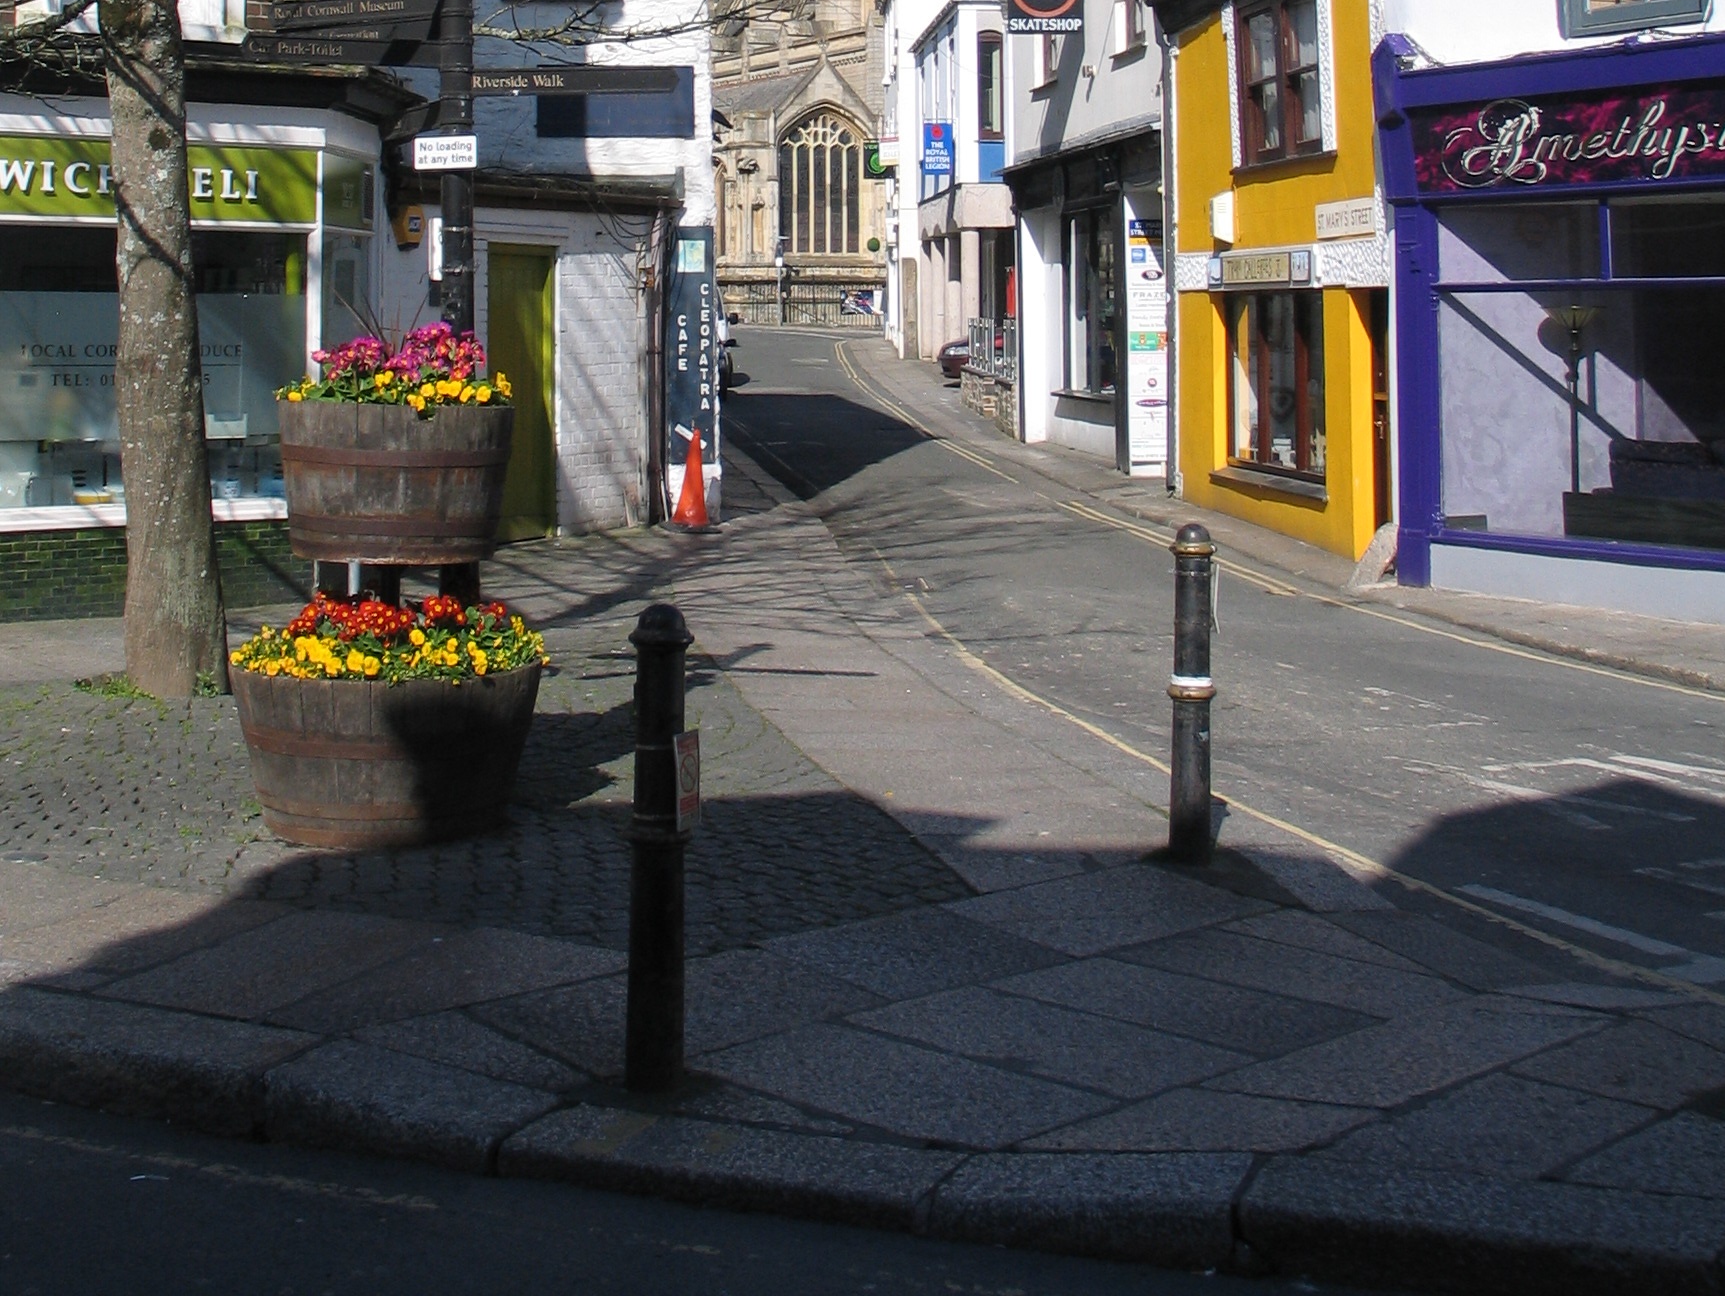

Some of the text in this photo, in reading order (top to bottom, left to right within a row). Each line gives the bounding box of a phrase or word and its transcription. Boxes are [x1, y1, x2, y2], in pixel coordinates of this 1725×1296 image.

[274, 0, 405, 21] Royal Cornwall Museum
[1010, 18, 1082, 31] SKATESHOP
[278, 42, 343, 56] Park-Toilet
[473, 74, 564, 88] Riverside Walk
[419, 141, 472, 154] No loading
[418, 154, 473, 166] at any time
[192, 167, 259, 200] ELI
[1351, 207, 1373, 226] STREET
[677, 314, 688, 371] CAFE
[699, 283, 711, 410] CLEOPATRA
[200, 344, 242, 357] DUCE
[51, 373, 90, 387] TEL:
